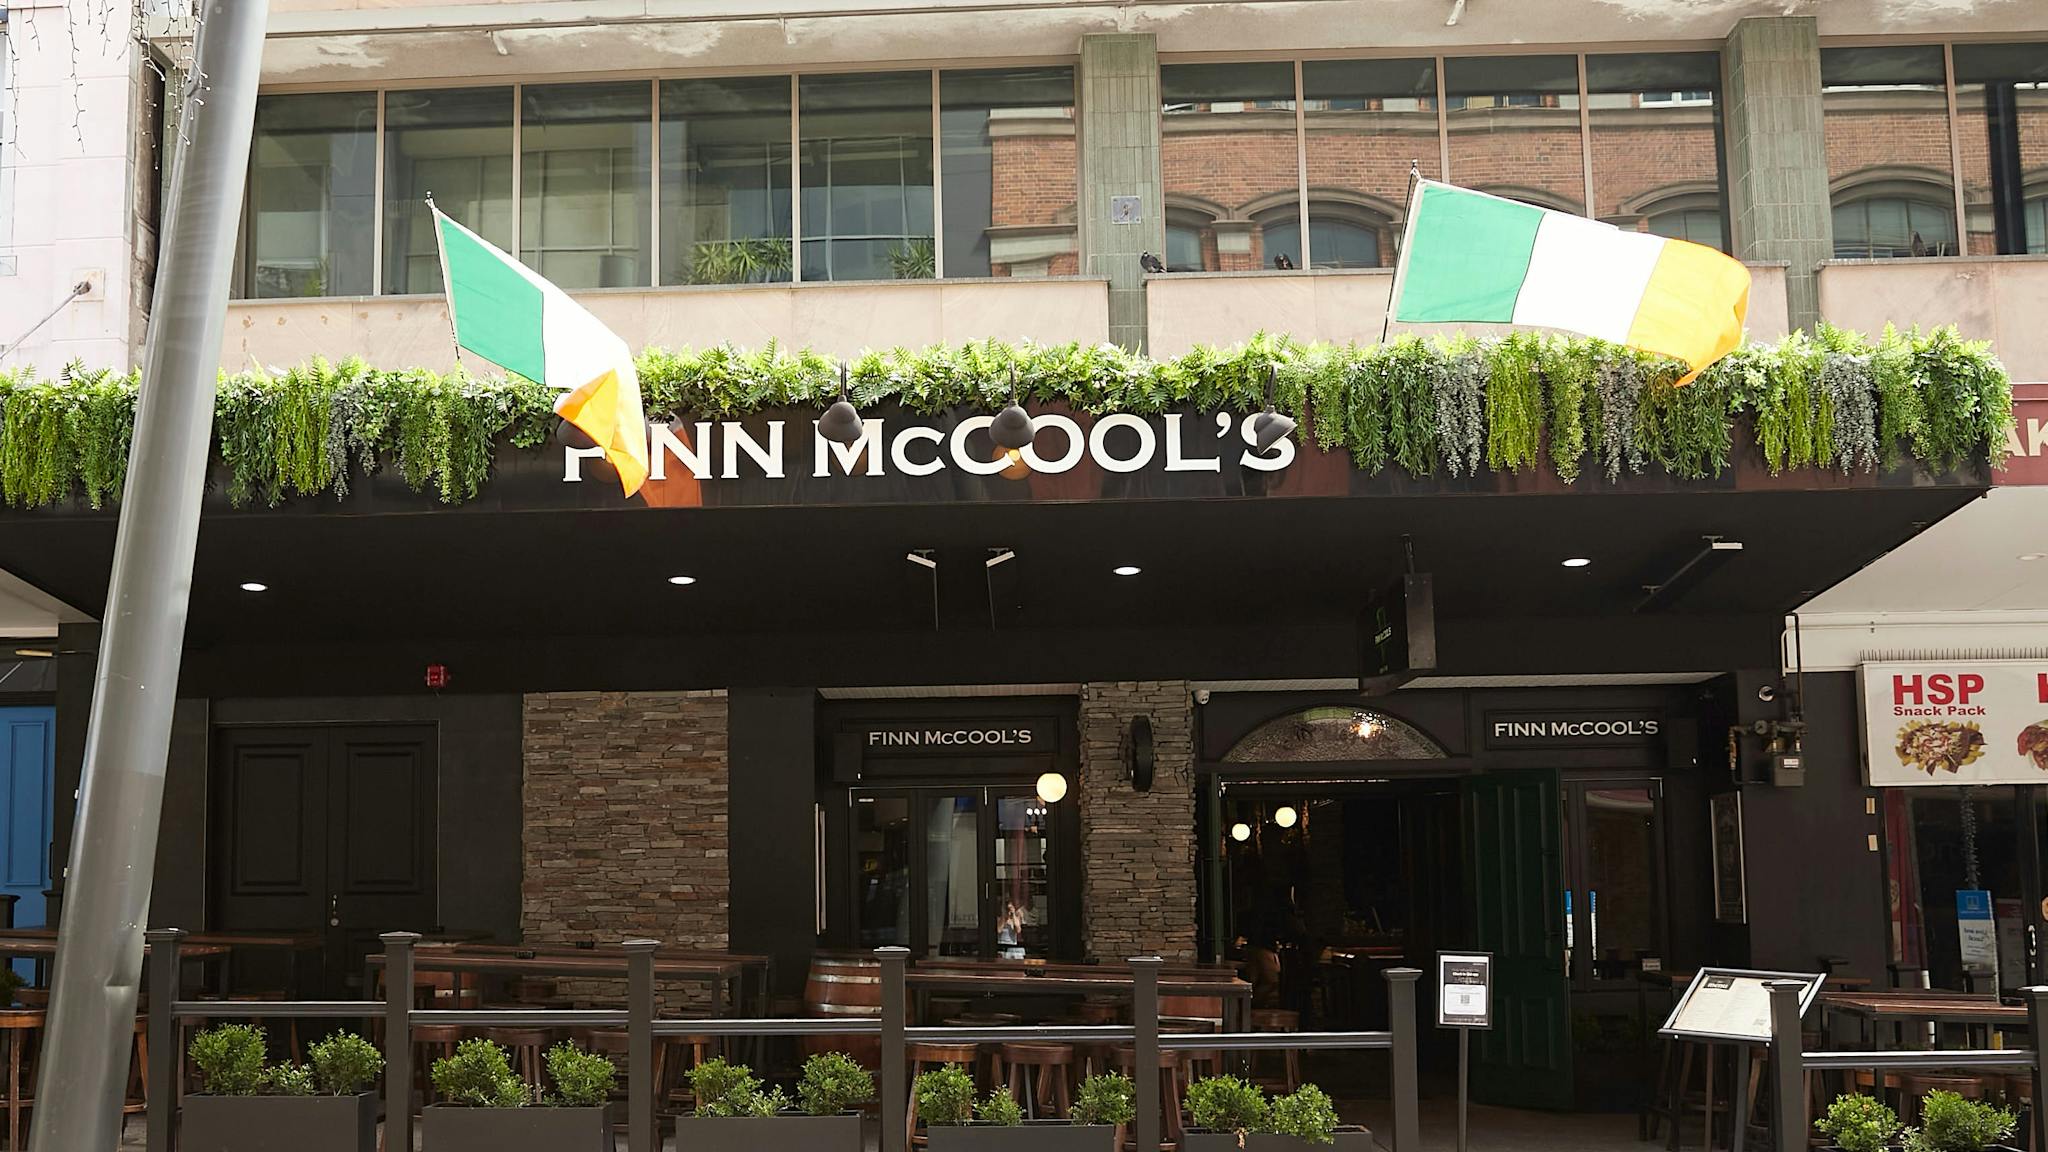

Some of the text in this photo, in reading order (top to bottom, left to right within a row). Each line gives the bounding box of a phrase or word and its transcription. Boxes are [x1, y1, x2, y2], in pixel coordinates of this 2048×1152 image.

[562, 420, 786, 482] FNN
[1893, 673, 1985, 705] HSP
[1893, 705, 1987, 717] Snack Pack
[1494, 722, 1546, 737] FINN
[869, 731, 919, 746] FINN
